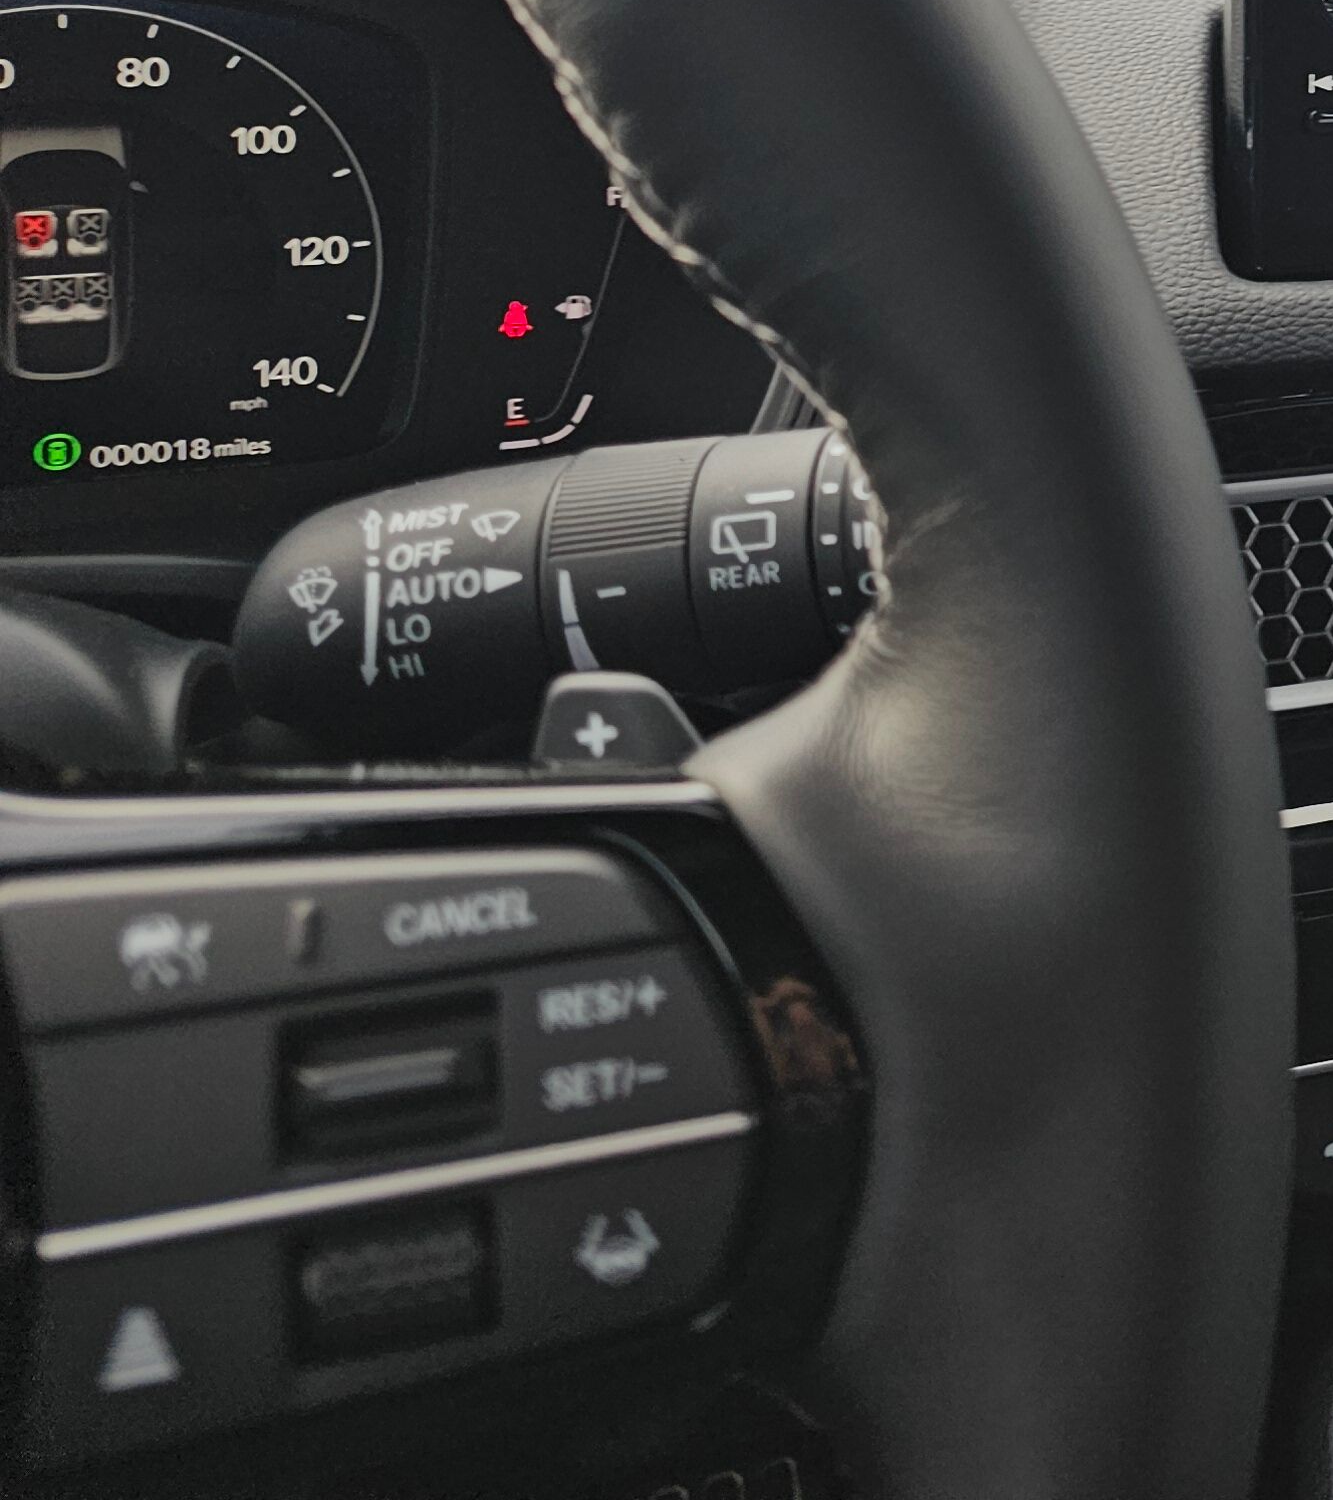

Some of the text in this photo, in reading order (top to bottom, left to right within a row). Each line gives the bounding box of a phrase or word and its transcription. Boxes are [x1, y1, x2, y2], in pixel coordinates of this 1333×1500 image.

[116, 56, 170, 88] 80
[230, 125, 297, 155] 100
[283, 235, 349, 267] 120
[252, 356, 318, 388] 140
[230, 396, 268, 412] mph
[507, 398, 525, 419] E
[89, 437, 271, 468] 000018 miles
[388, 503, 469, 534] MIST
[386, 538, 454, 572] OFF
[386, 567, 482, 608] AUTO
[709, 561, 780, 590] REAR
[386, 613, 431, 646] LO
[388, 653, 425, 680] HI
[384, 886, 537, 946] CANCEL
[538, 975, 667, 1033] RES/+
[541, 1056, 669, 1112] SET/-
